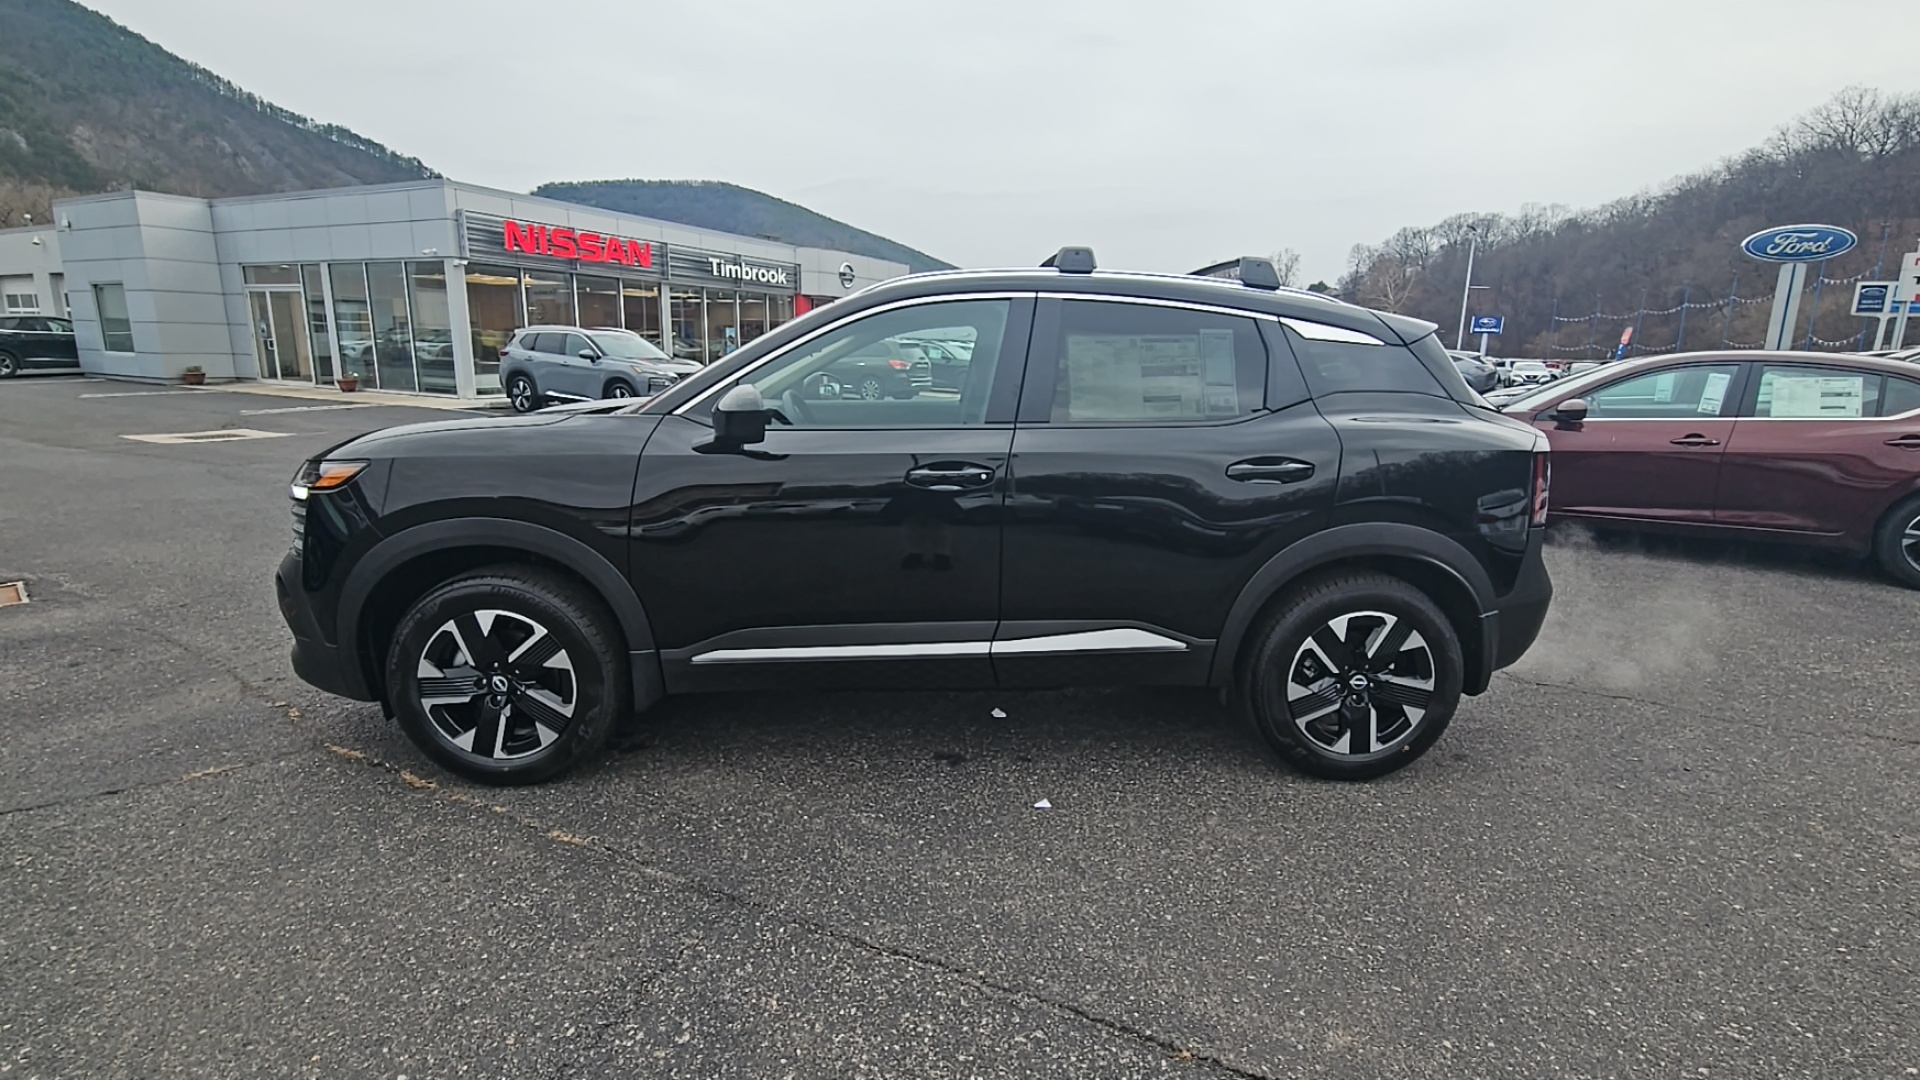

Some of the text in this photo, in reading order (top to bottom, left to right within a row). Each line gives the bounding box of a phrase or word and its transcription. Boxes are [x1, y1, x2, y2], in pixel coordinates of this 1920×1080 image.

[504, 220, 652, 268] NISSAN
[1766, 232, 1834, 255] Ford
[707, 256, 787, 285] Timbrook
